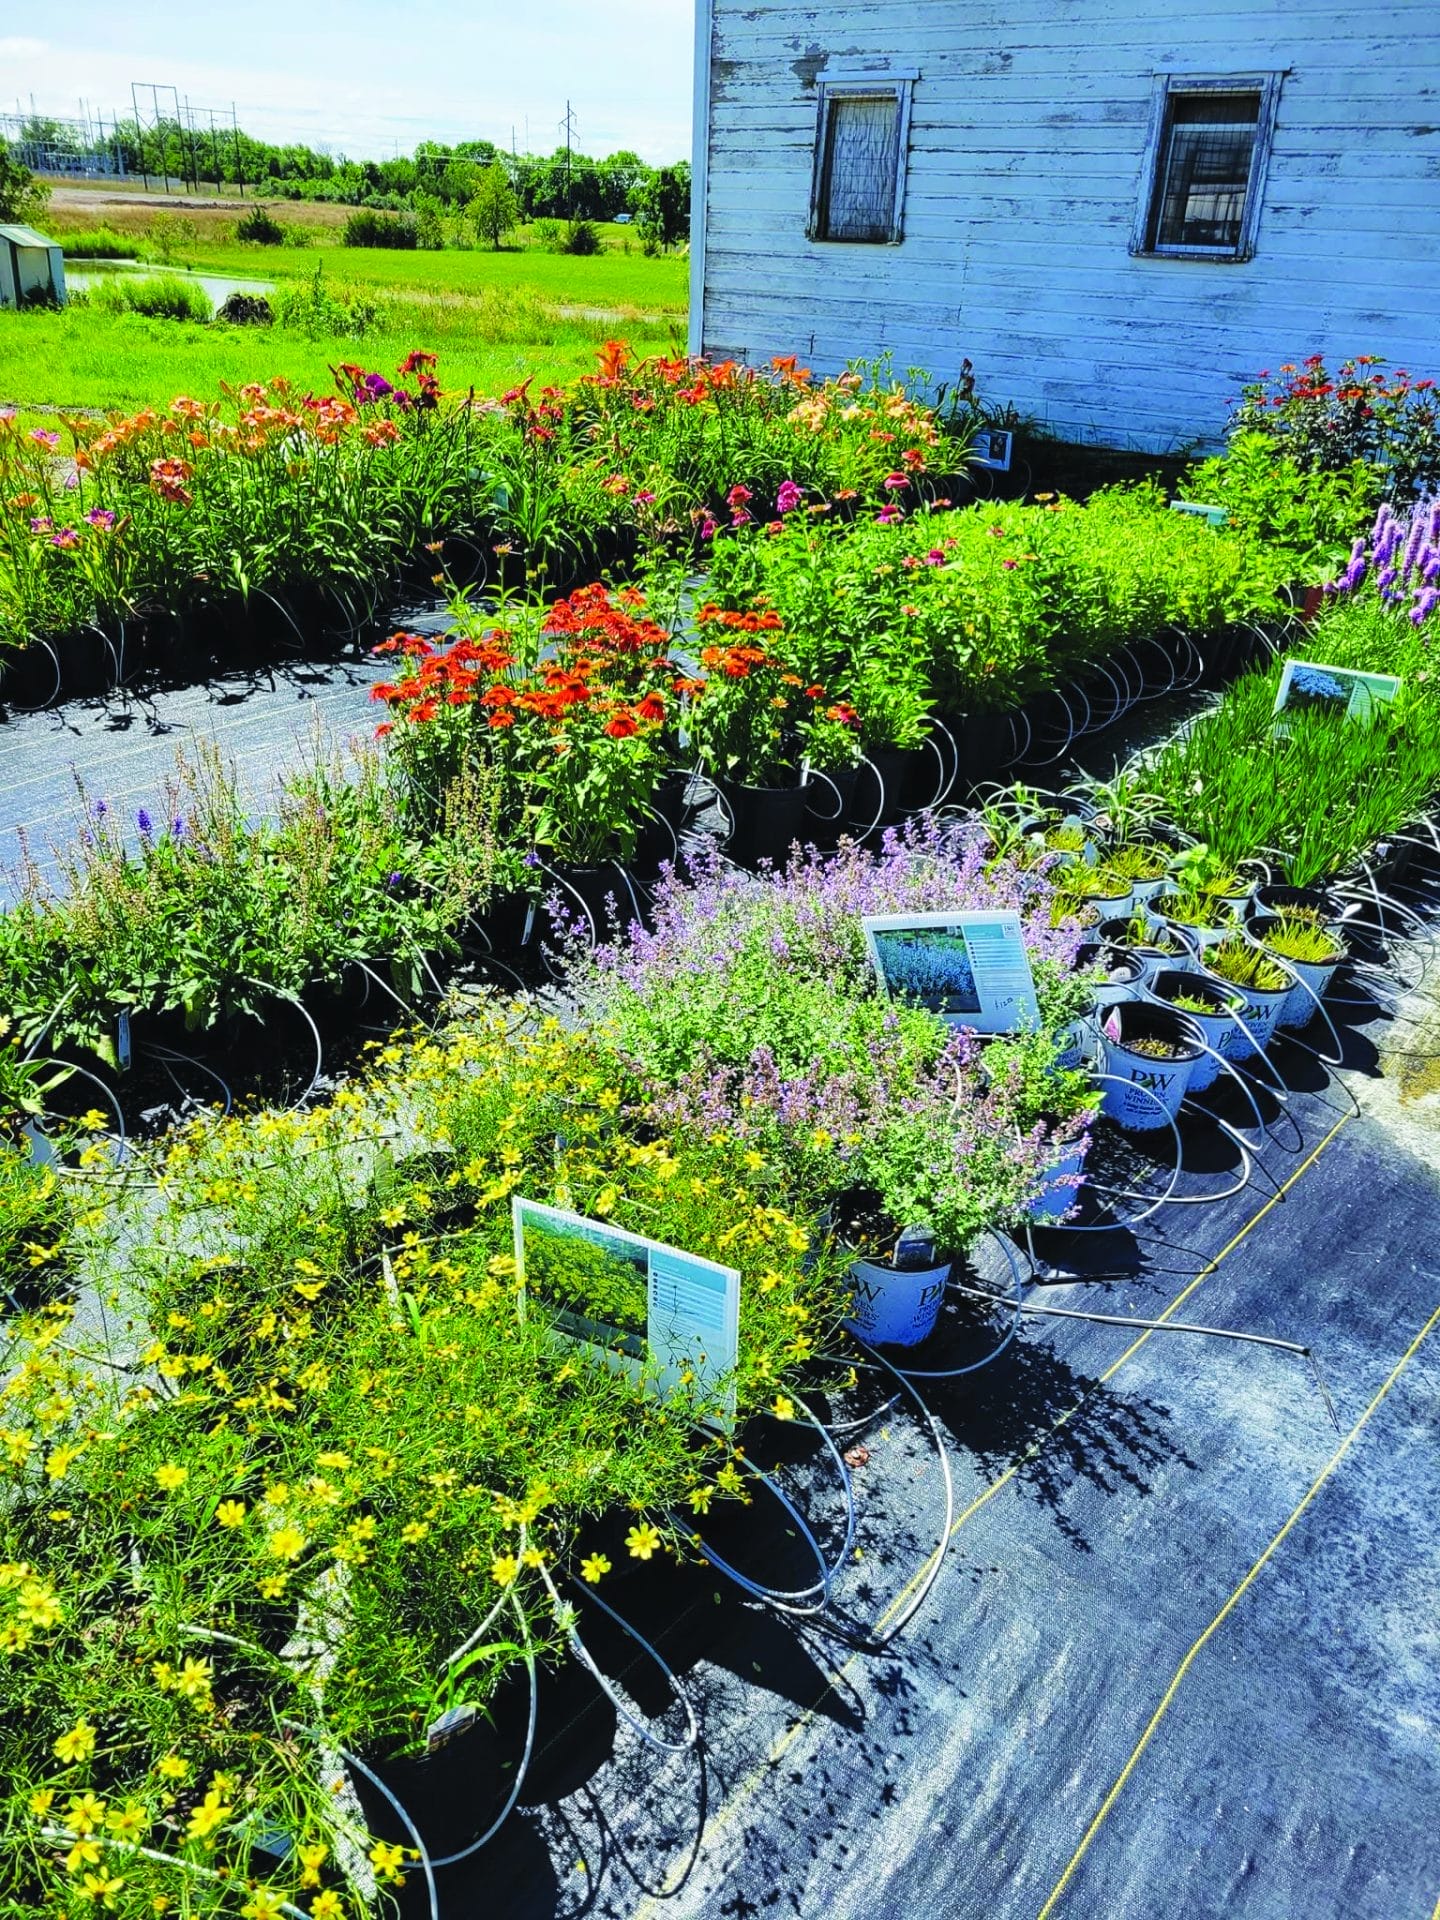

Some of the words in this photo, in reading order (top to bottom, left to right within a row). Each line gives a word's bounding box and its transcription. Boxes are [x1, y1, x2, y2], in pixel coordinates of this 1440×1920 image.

[1216, 1030, 1233, 1049] P
[1131, 1068, 1177, 1091] PW
[1129, 1087, 1167, 1098] PROEN
